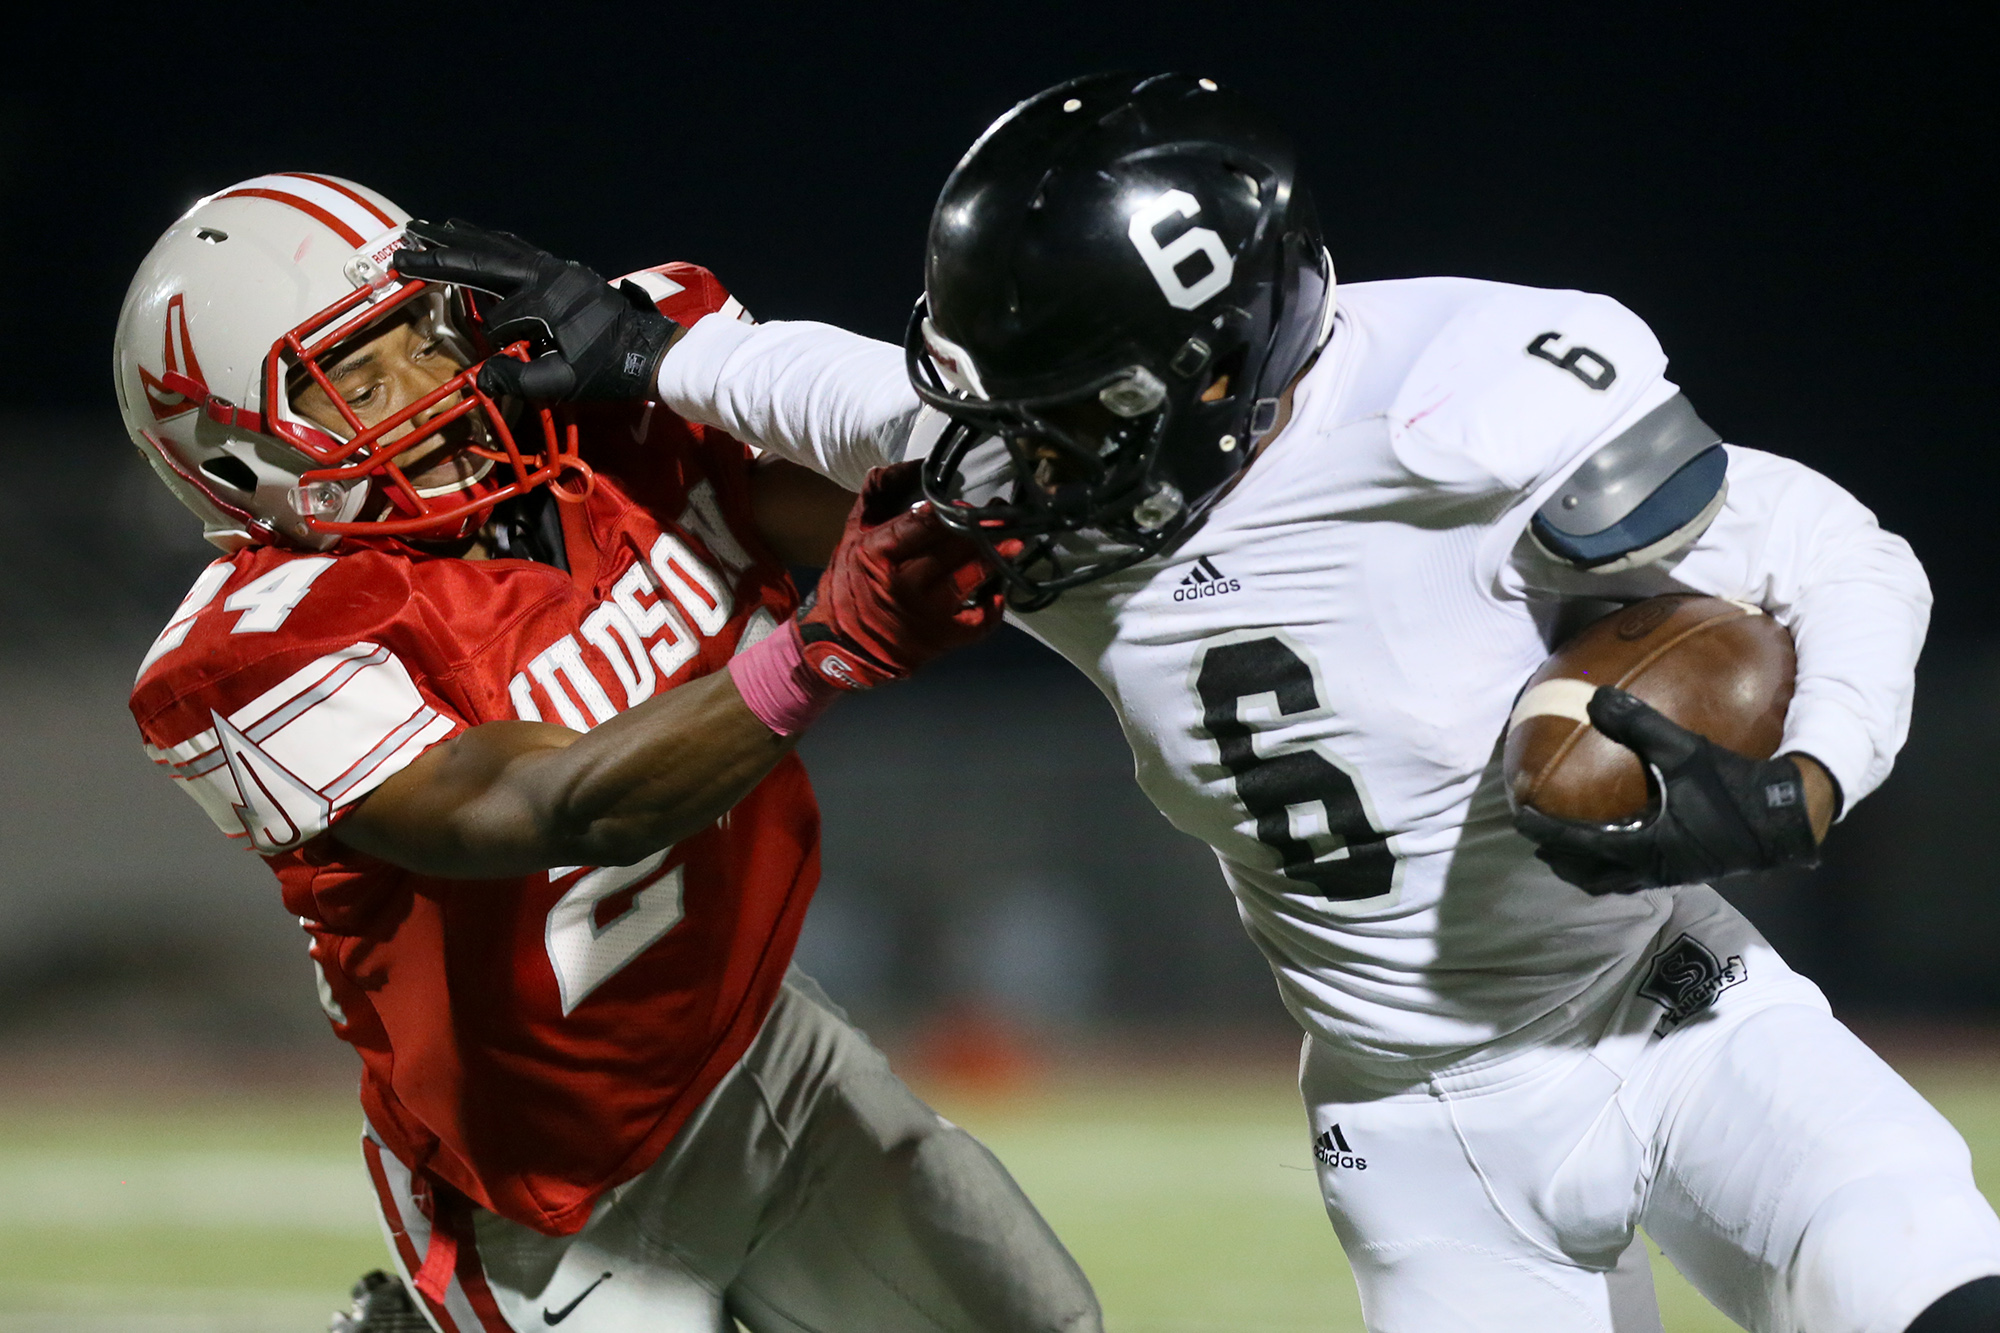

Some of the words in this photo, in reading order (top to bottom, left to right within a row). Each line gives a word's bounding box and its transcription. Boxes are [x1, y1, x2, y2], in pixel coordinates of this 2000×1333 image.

[1129, 189, 1234, 310] 6
[1526, 331, 1617, 391] 6
[134, 557, 337, 686] 24
[1173, 579, 1241, 602] adidas
[1190, 632, 1402, 908] 6
[1313, 1144, 1368, 1171] adidas
